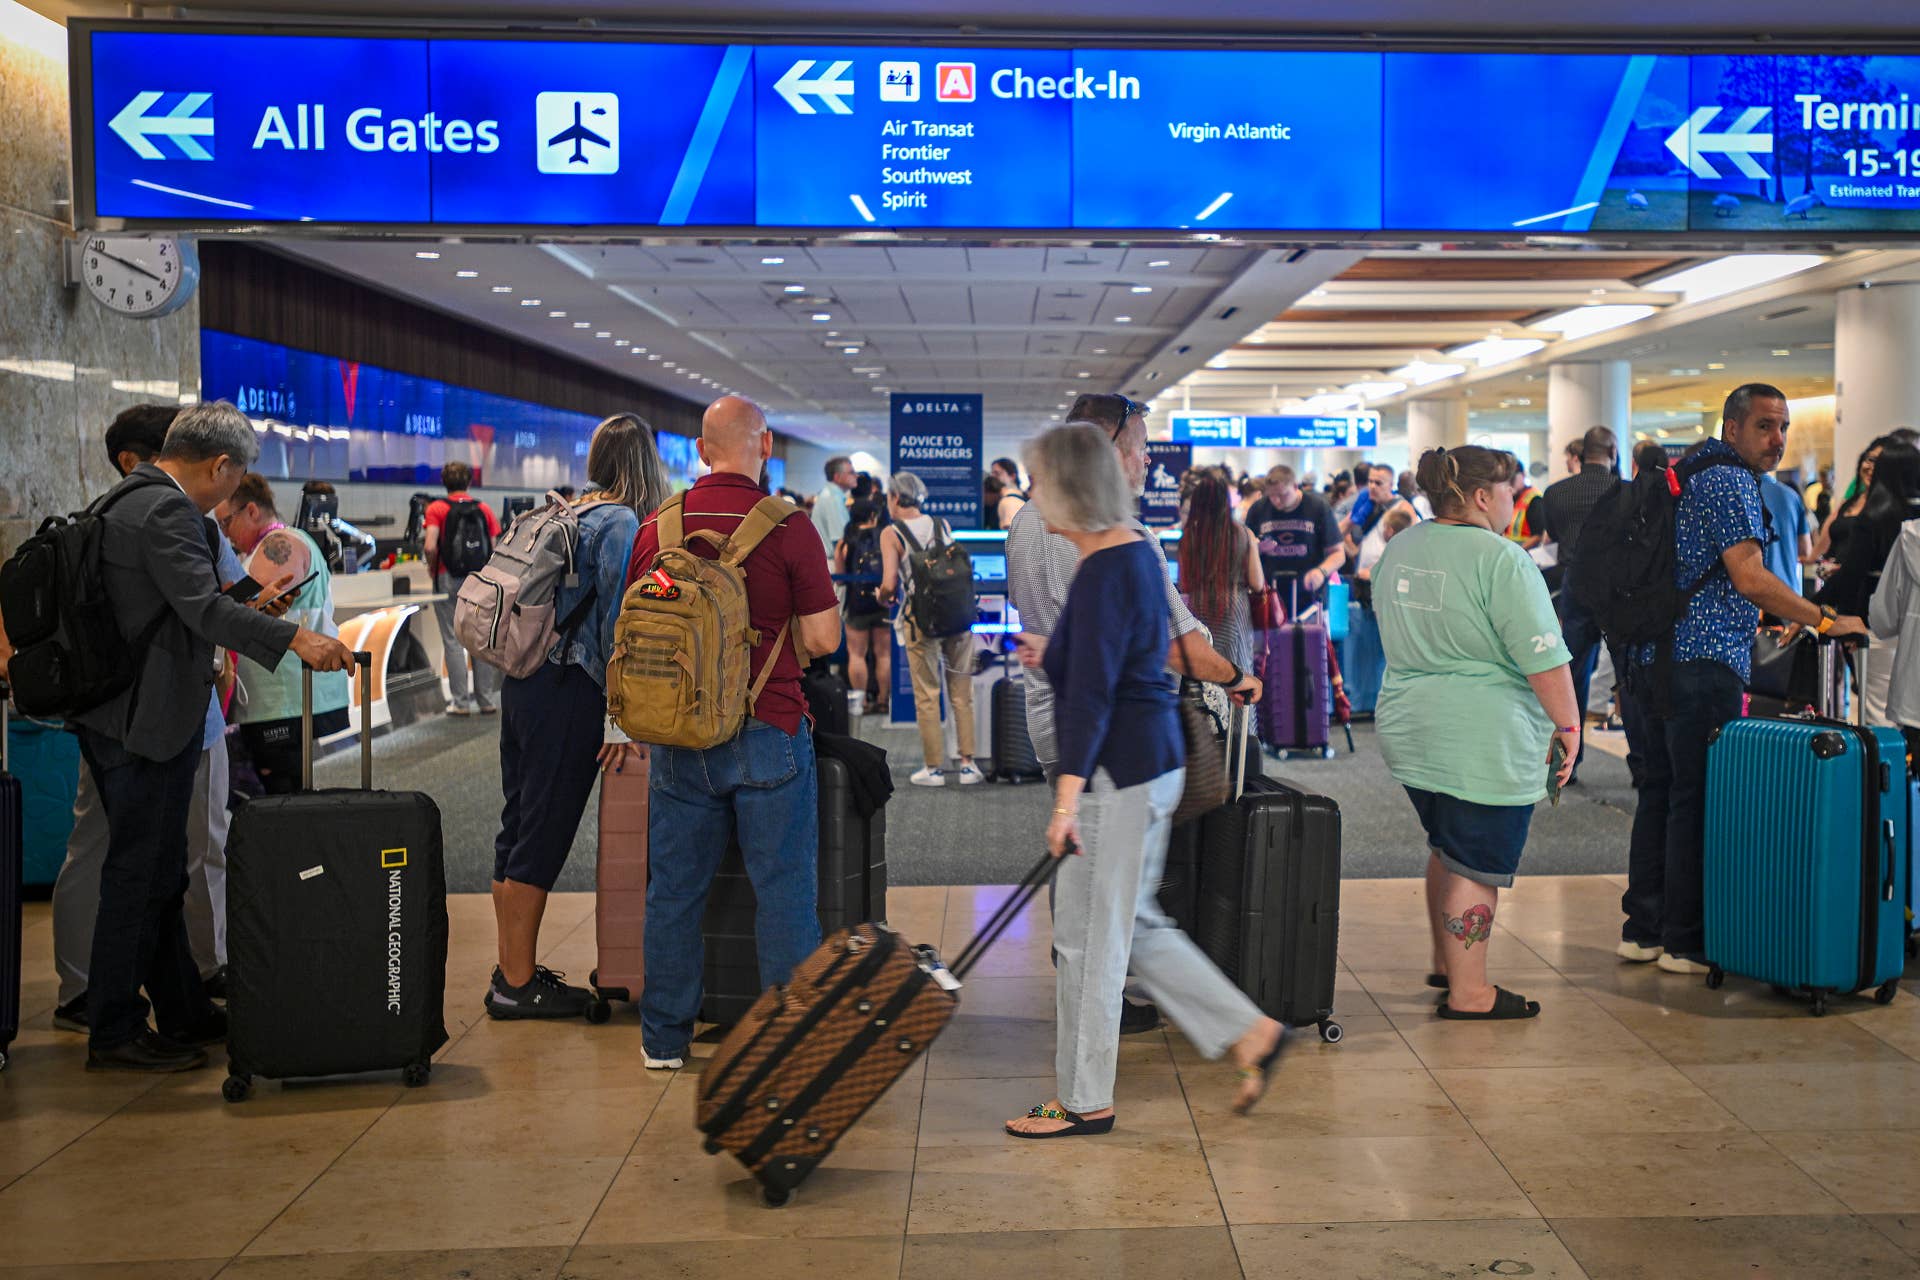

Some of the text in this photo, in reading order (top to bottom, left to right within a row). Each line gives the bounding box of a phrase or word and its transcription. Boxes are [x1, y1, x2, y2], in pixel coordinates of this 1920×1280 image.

[941, 67, 1140, 99] A Check-In
[252, 103, 500, 153] All Gates
[881, 120, 975, 137] Air Transat
[1168, 122, 1291, 143] Virgin Atlantic
[881, 143, 951, 160] Frontier
[881, 167, 972, 185] Southwest
[1829, 184, 1893, 197] Estimated
[881, 191, 928, 211] Spirit
[94, 240, 106, 251] 10
[160, 243, 167, 255] 2
[91, 257, 98, 269] 9
[164, 261, 172, 273] 3
[96, 275, 103, 286] 8
[159, 279, 167, 290] 4
[109, 288, 116, 299] 7
[145, 290, 153, 302] 5
[126, 295, 134, 306] 6
[249, 387, 286, 414] DELTA
[916, 402, 960, 413] DELTA
[900, 435, 964, 446] ADVICE TO
[900, 448, 974, 459] PASSENGERS
[387, 869, 402, 1011] NATIONAL GEOGRAPHIC
